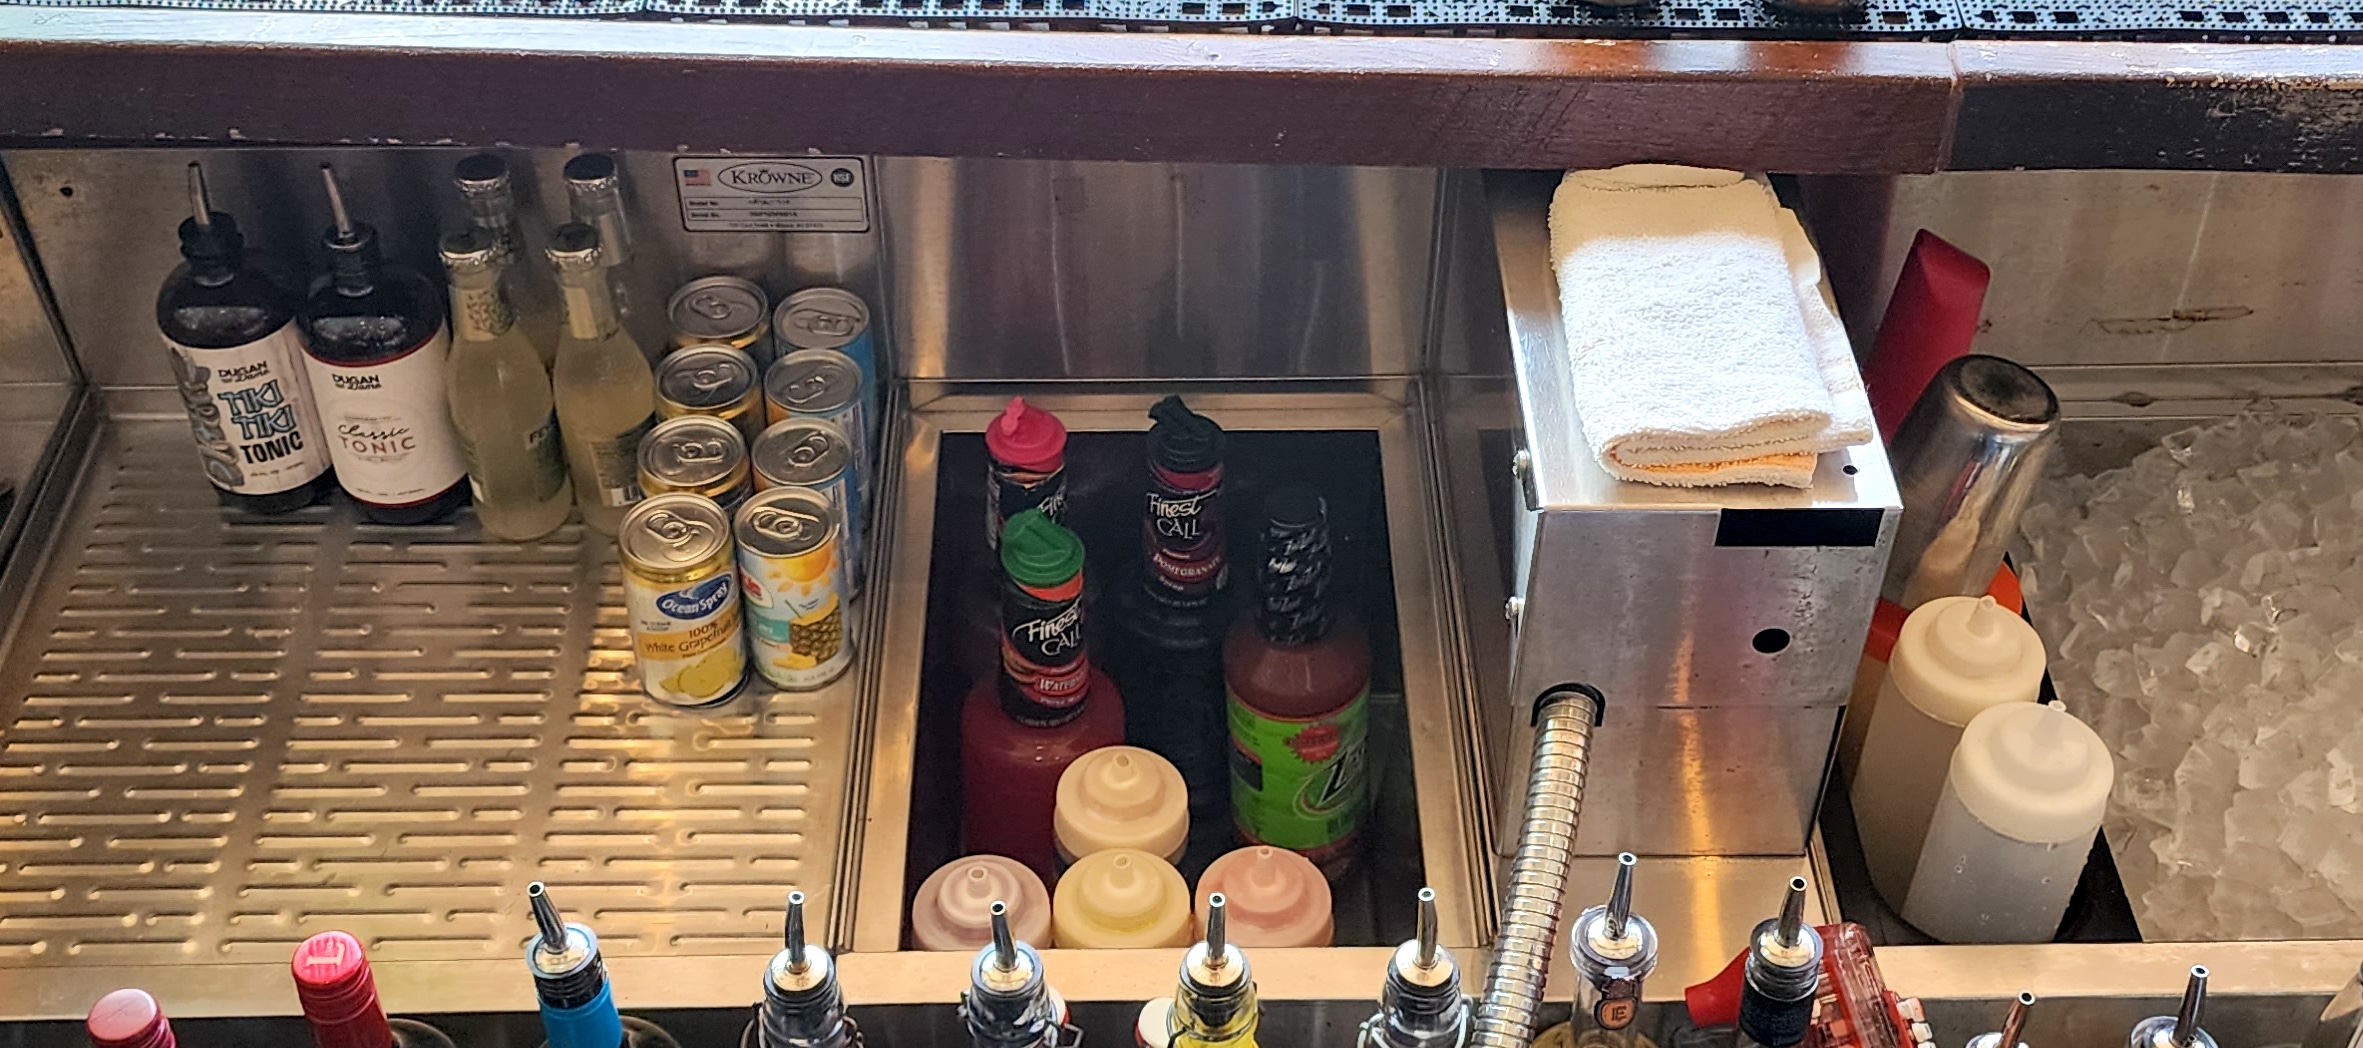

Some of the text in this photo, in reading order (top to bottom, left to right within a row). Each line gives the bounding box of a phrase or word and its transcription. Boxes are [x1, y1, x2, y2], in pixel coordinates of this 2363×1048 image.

[731, 169, 815, 185] KROWNE
[217, 360, 268, 378] DUGAN
[331, 373, 379, 385] DUGAN
[216, 378, 285, 416] TIKI
[230, 404, 297, 440] TIKI
[337, 423, 411, 441] Classic
[239, 430, 304, 464] TONIC
[337, 434, 416, 454] TONIC
[1146, 489, 1217, 518] Finest
[1156, 518, 1201, 540] CALL
[661, 581, 728, 614] Ocean Spray
[689, 620, 719, 639] 100%
[1012, 594, 1082, 643] Finest
[645, 642, 675, 654] White
[1040, 624, 1082, 657] CALL
